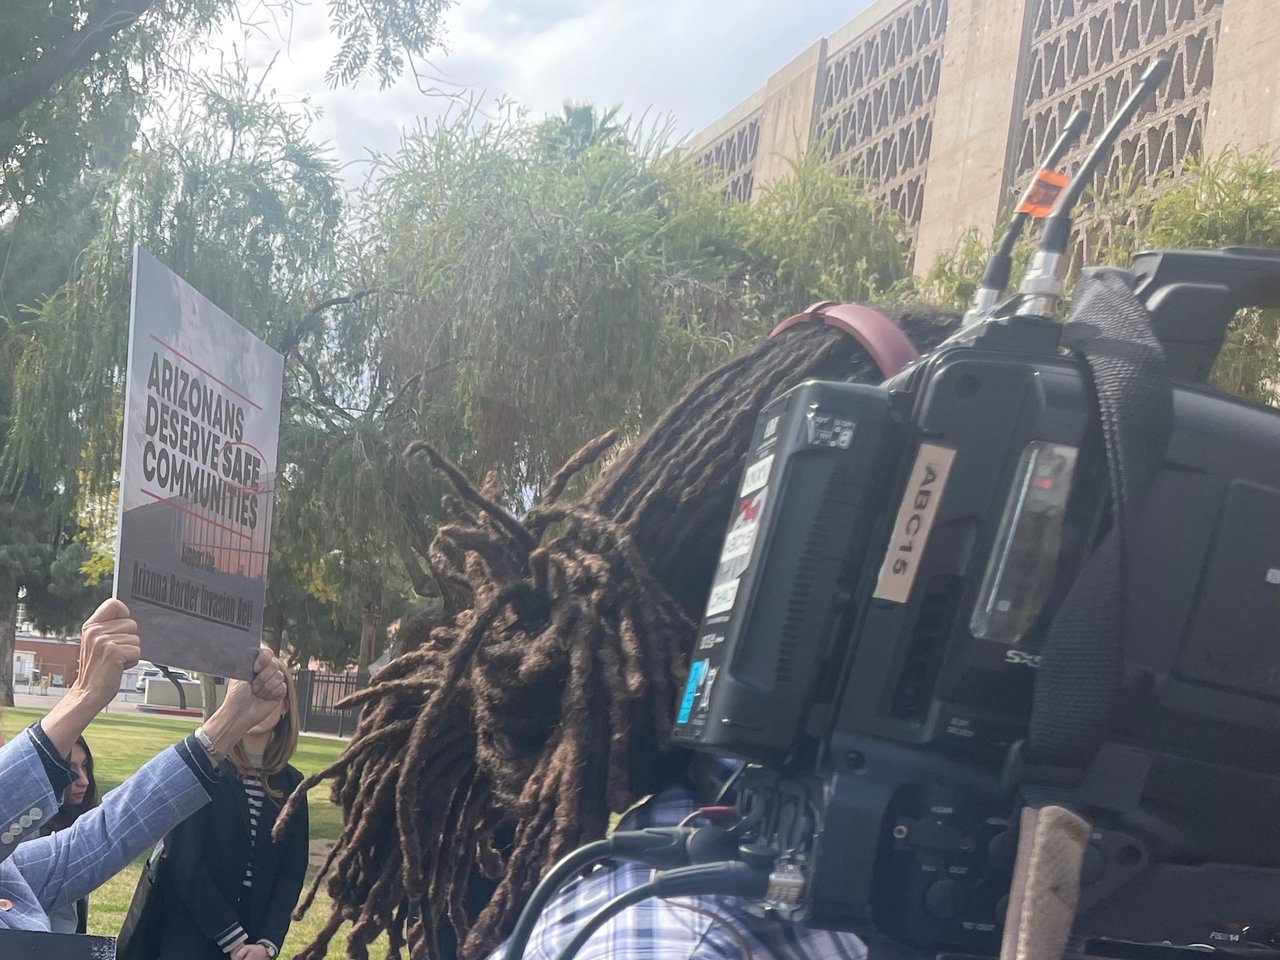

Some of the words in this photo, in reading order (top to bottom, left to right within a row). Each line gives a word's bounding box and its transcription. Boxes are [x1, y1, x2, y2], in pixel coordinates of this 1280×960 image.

[146, 394, 220, 473] DESERVE
[222, 441, 260, 490] SAFE
[147, 351, 244, 443] ARIZONANS
[143, 440, 259, 531] COMMUNITIES
[893, 464, 937, 576] ABC15
[131, 560, 168, 604] Arizona
[169, 573, 199, 614] Border
[200, 584, 237, 624] Invasion
[236, 597, 254, 628] Act!
